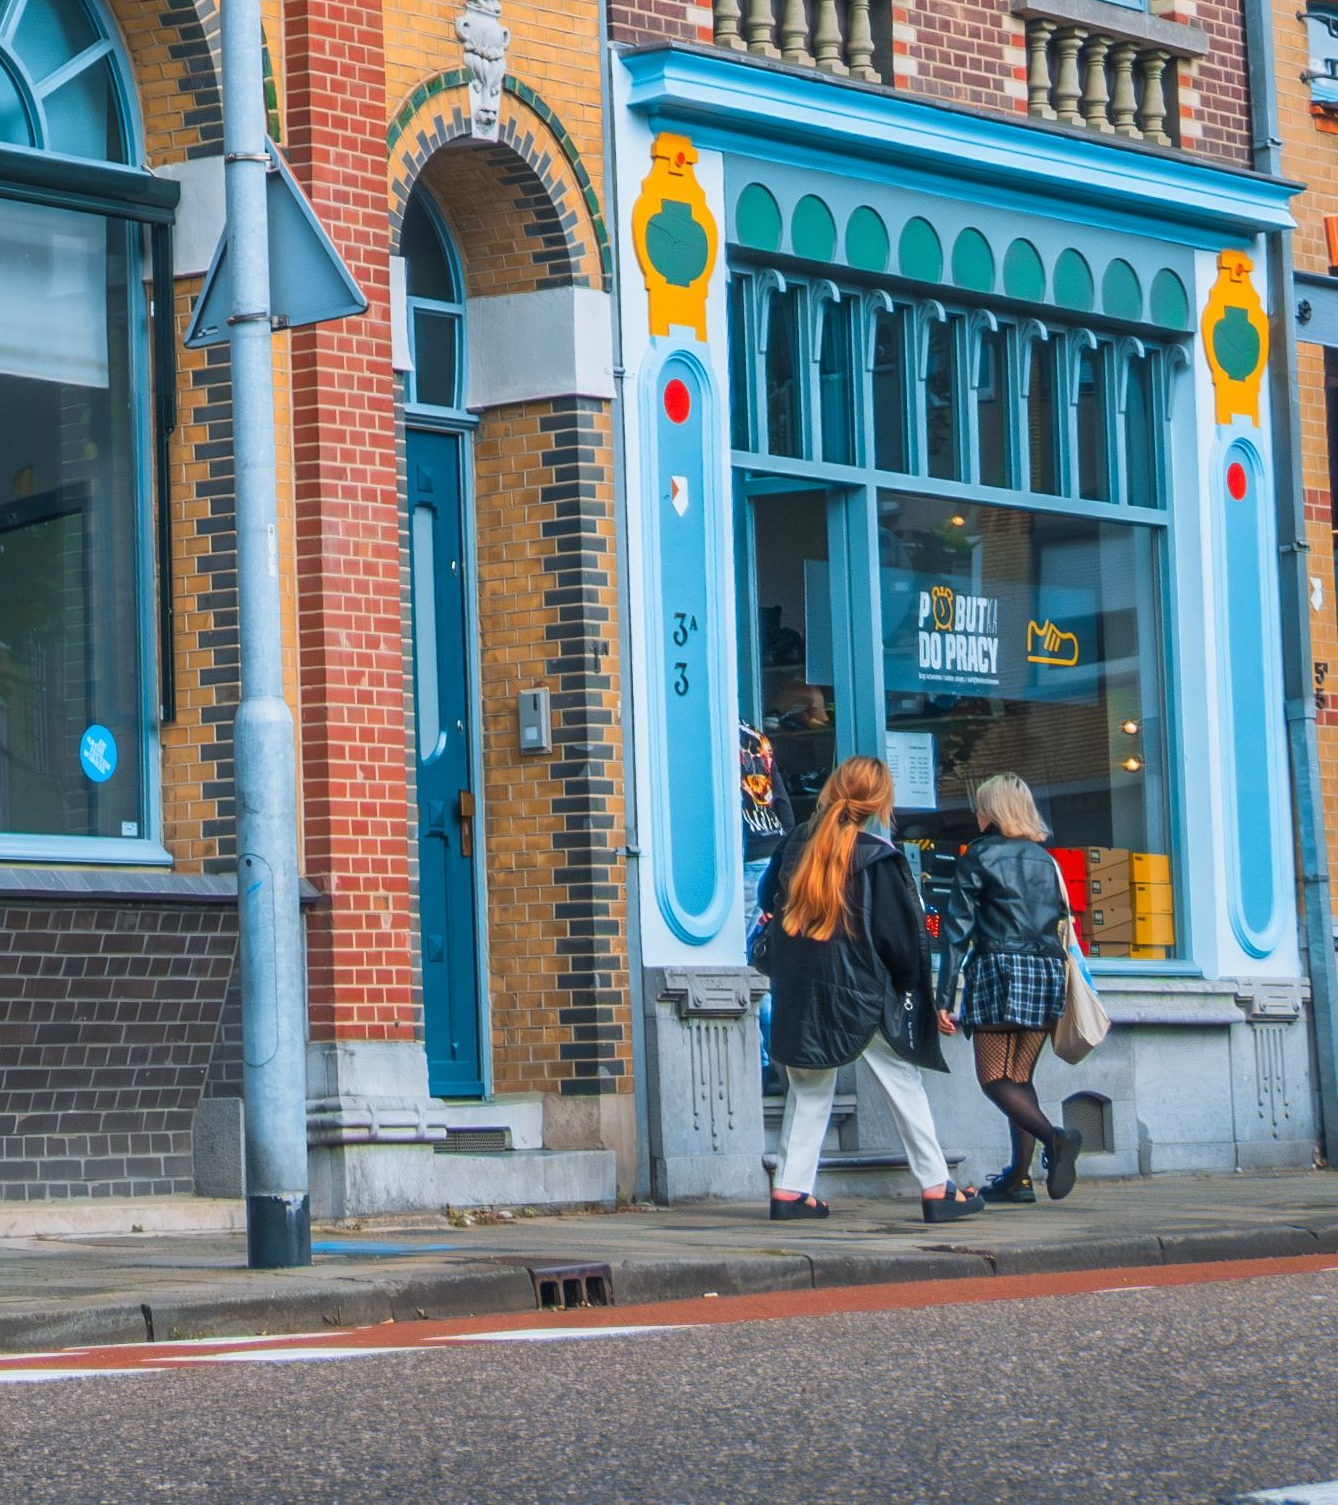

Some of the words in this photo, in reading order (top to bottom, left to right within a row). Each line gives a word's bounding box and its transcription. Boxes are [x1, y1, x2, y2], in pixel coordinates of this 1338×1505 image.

[673, 612, 698, 647] 3A
[918, 631, 942, 670] DO
[944, 633, 999, 674] PRACY
[674, 662, 689, 696] 3
